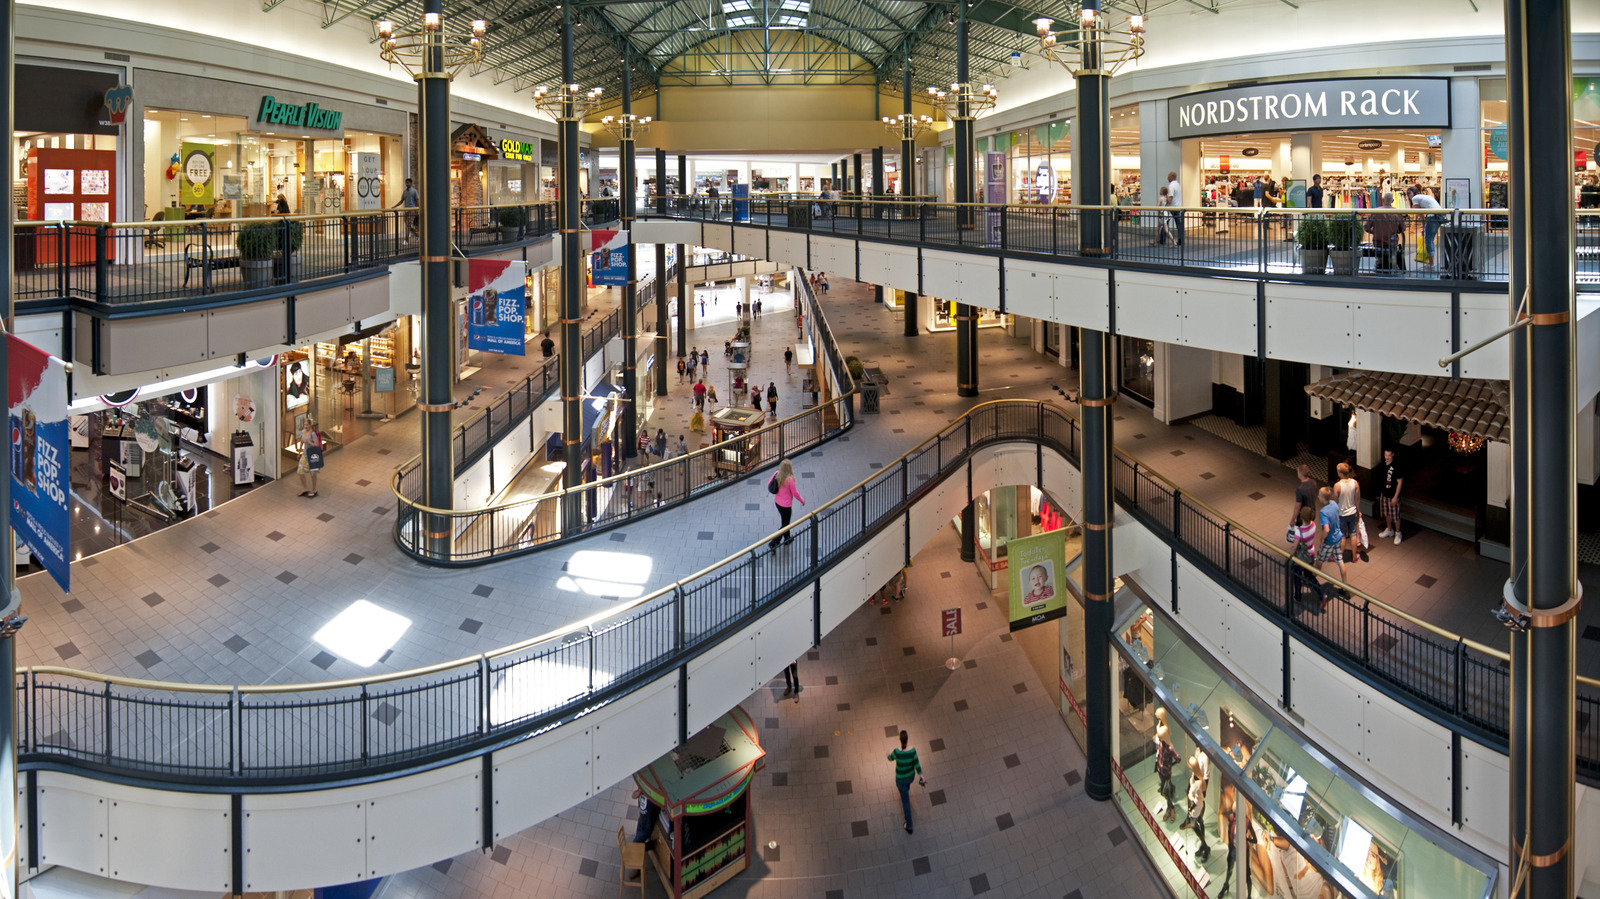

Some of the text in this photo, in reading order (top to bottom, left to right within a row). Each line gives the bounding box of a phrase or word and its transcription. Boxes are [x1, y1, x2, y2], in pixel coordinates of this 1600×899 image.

[258, 96, 343, 131] PEARLE VISION
[1179, 91, 1328, 128] NORDSTROM
[502, 139, 532, 154] GOLDMAX
[190, 169, 208, 177] FREE
[498, 298, 520, 308] FIZZ.
[498, 306, 519, 315] POP.
[498, 313, 524, 324] SHOP.
[37, 435, 62, 470] FIZZ.
[37, 452, 60, 486] POP.
[37, 470, 68, 511] SHOP.
